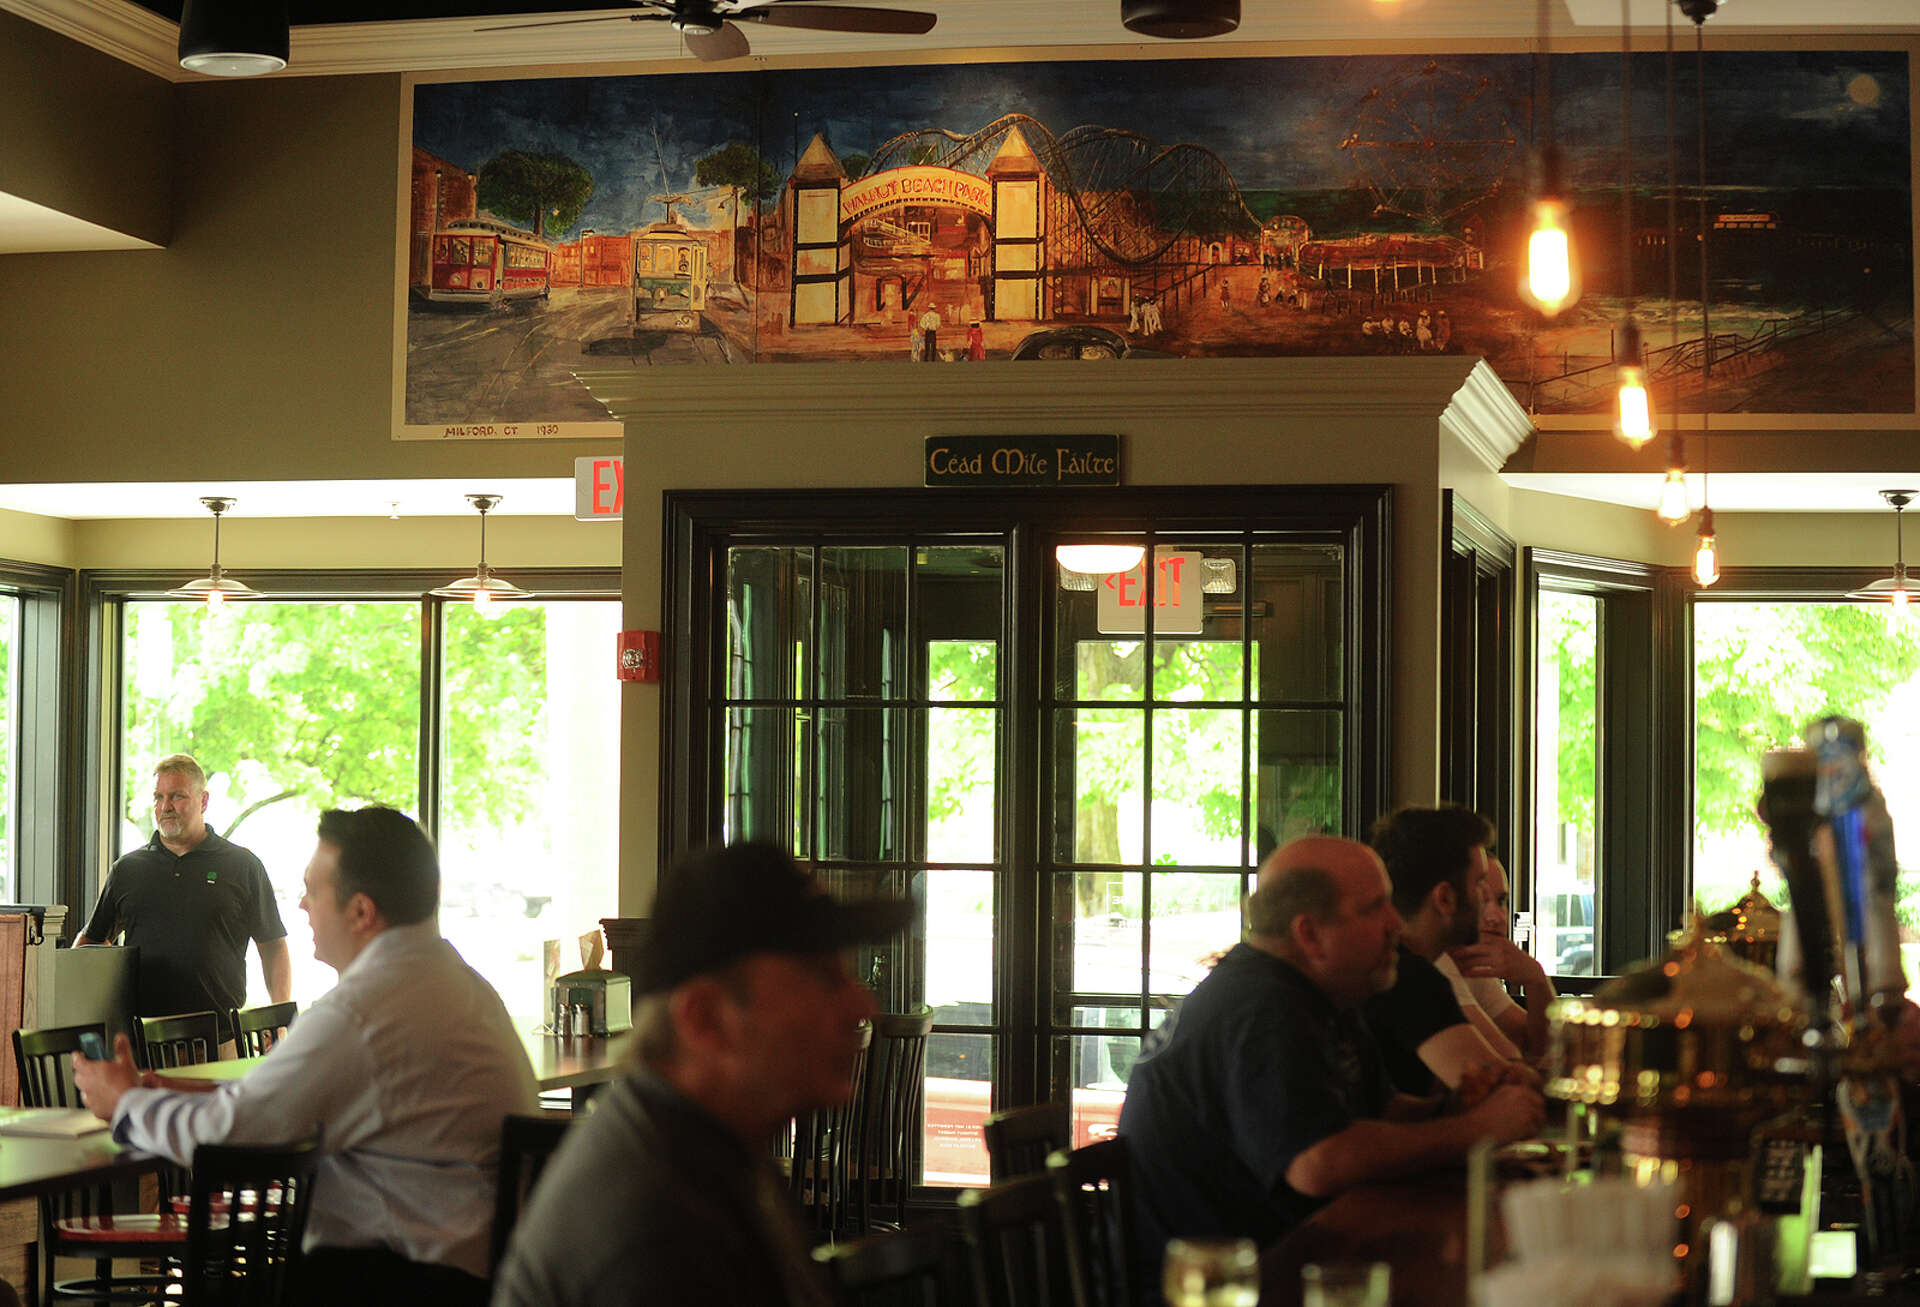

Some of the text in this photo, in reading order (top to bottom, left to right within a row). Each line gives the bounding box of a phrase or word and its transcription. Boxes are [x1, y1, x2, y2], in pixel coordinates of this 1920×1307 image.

[842, 178, 990, 215] WALNUT BEACH PARK
[536, 424, 559, 436] 1930
[1119, 557, 1185, 607] EXIT
